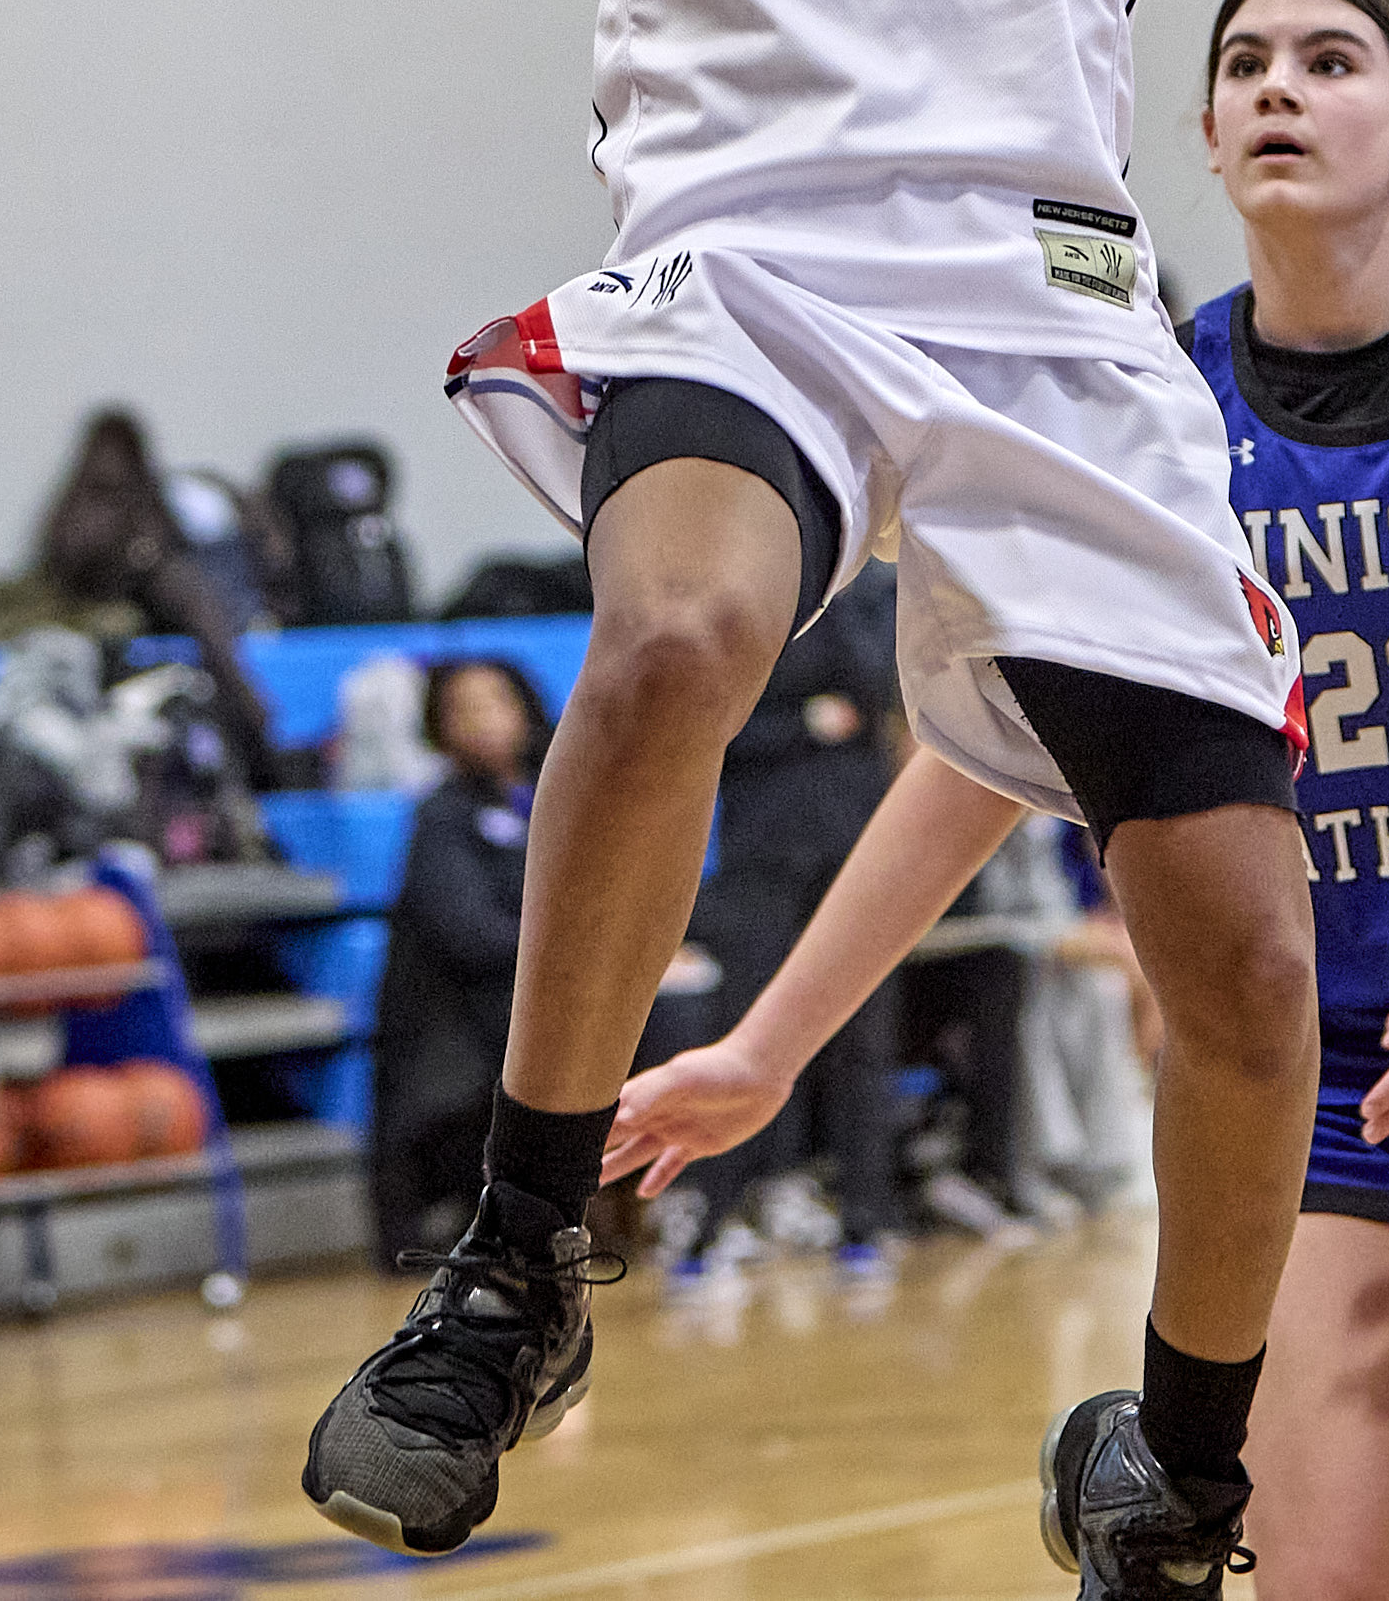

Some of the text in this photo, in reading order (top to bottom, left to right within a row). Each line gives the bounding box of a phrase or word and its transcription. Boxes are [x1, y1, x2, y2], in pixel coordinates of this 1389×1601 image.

[1037, 204, 1129, 230] NEW JERSEY SETS
